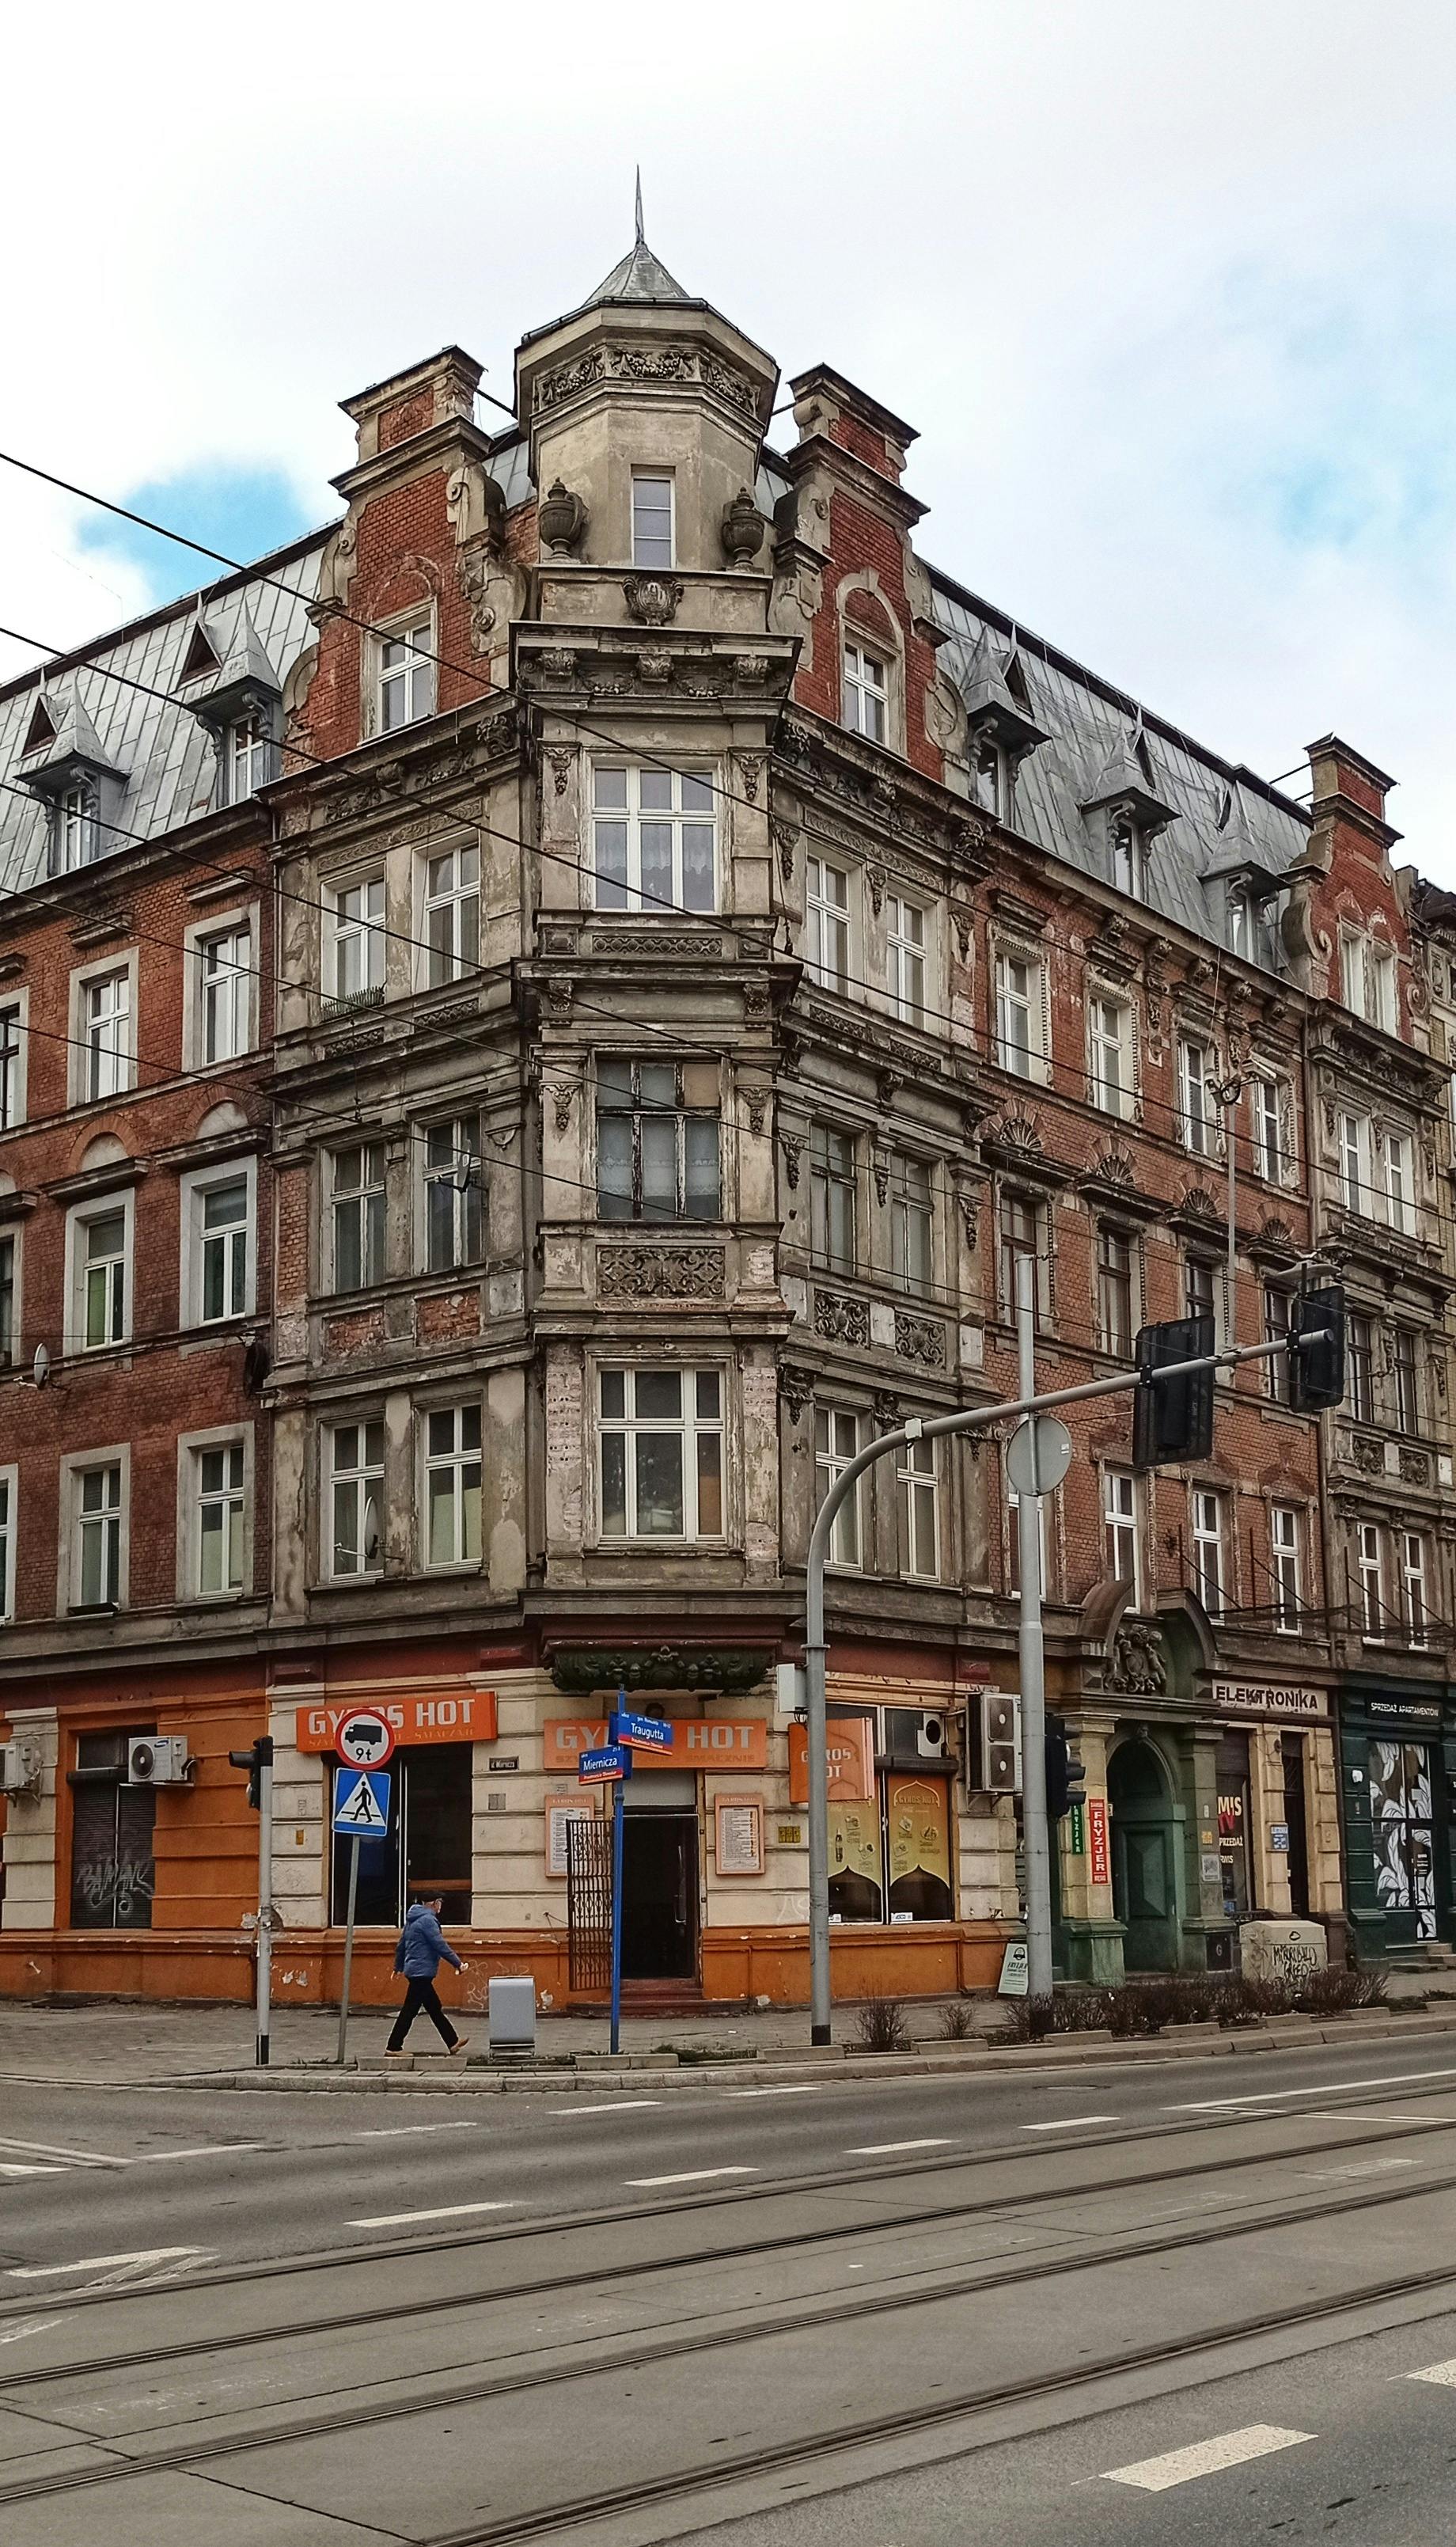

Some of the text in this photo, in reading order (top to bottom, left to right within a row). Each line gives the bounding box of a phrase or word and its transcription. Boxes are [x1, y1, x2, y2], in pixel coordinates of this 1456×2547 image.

[1216, 1686, 1318, 1710] ELEKTRONIKA
[309, 1699, 475, 1735] GYS HOT
[631, 1722, 664, 1740] Traugutta
[687, 1725, 754, 1748] HOT
[583, 1757, 617, 1771] Miernicza
[801, 1748, 852, 1763] GROS
[1218, 1796, 1242, 1816] MIS
[1094, 1811, 1105, 1871] FRYZJER
[1219, 1835, 1243, 1847] PRZEDAŻ
